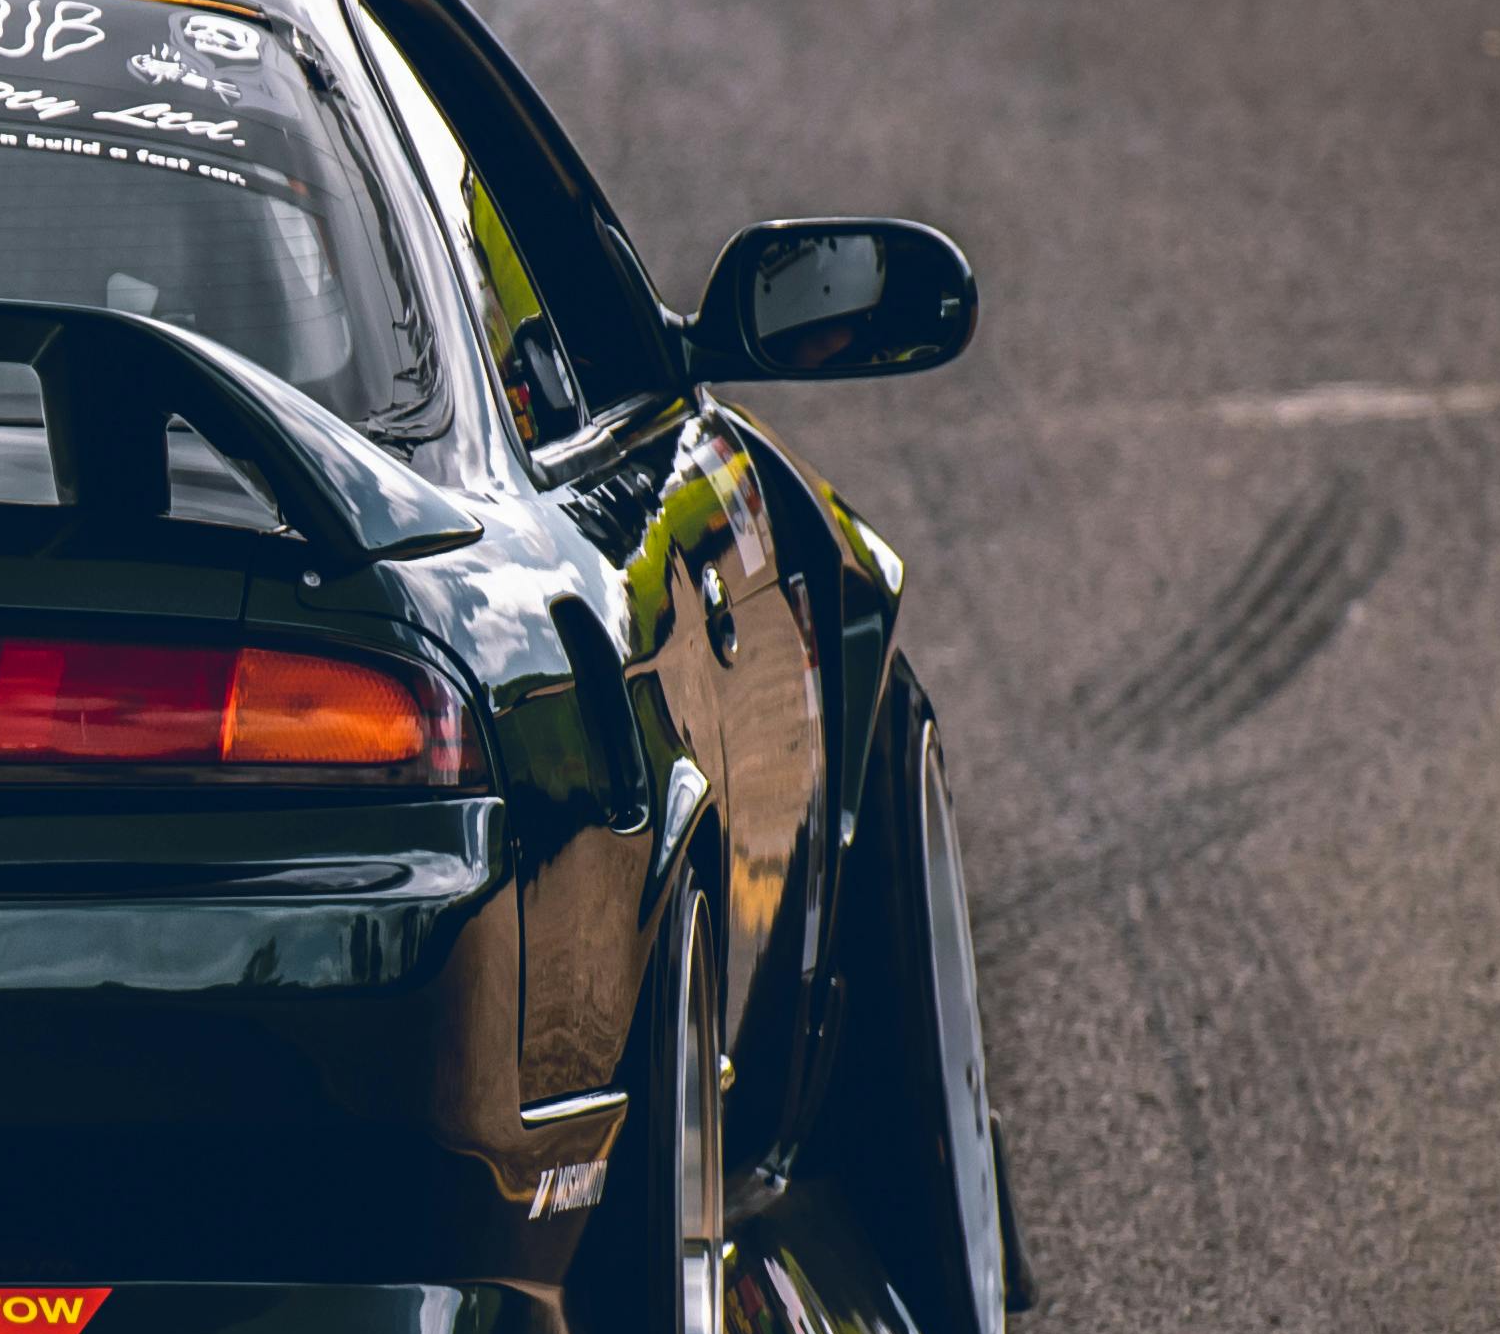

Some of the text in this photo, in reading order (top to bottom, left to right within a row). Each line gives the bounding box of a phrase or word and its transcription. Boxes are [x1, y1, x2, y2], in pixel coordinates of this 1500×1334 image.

[92, 102, 246, 147] Ltd.
[26, 133, 101, 156] build
[109, 147, 129, 160] a
[136, 149, 191, 171] fast
